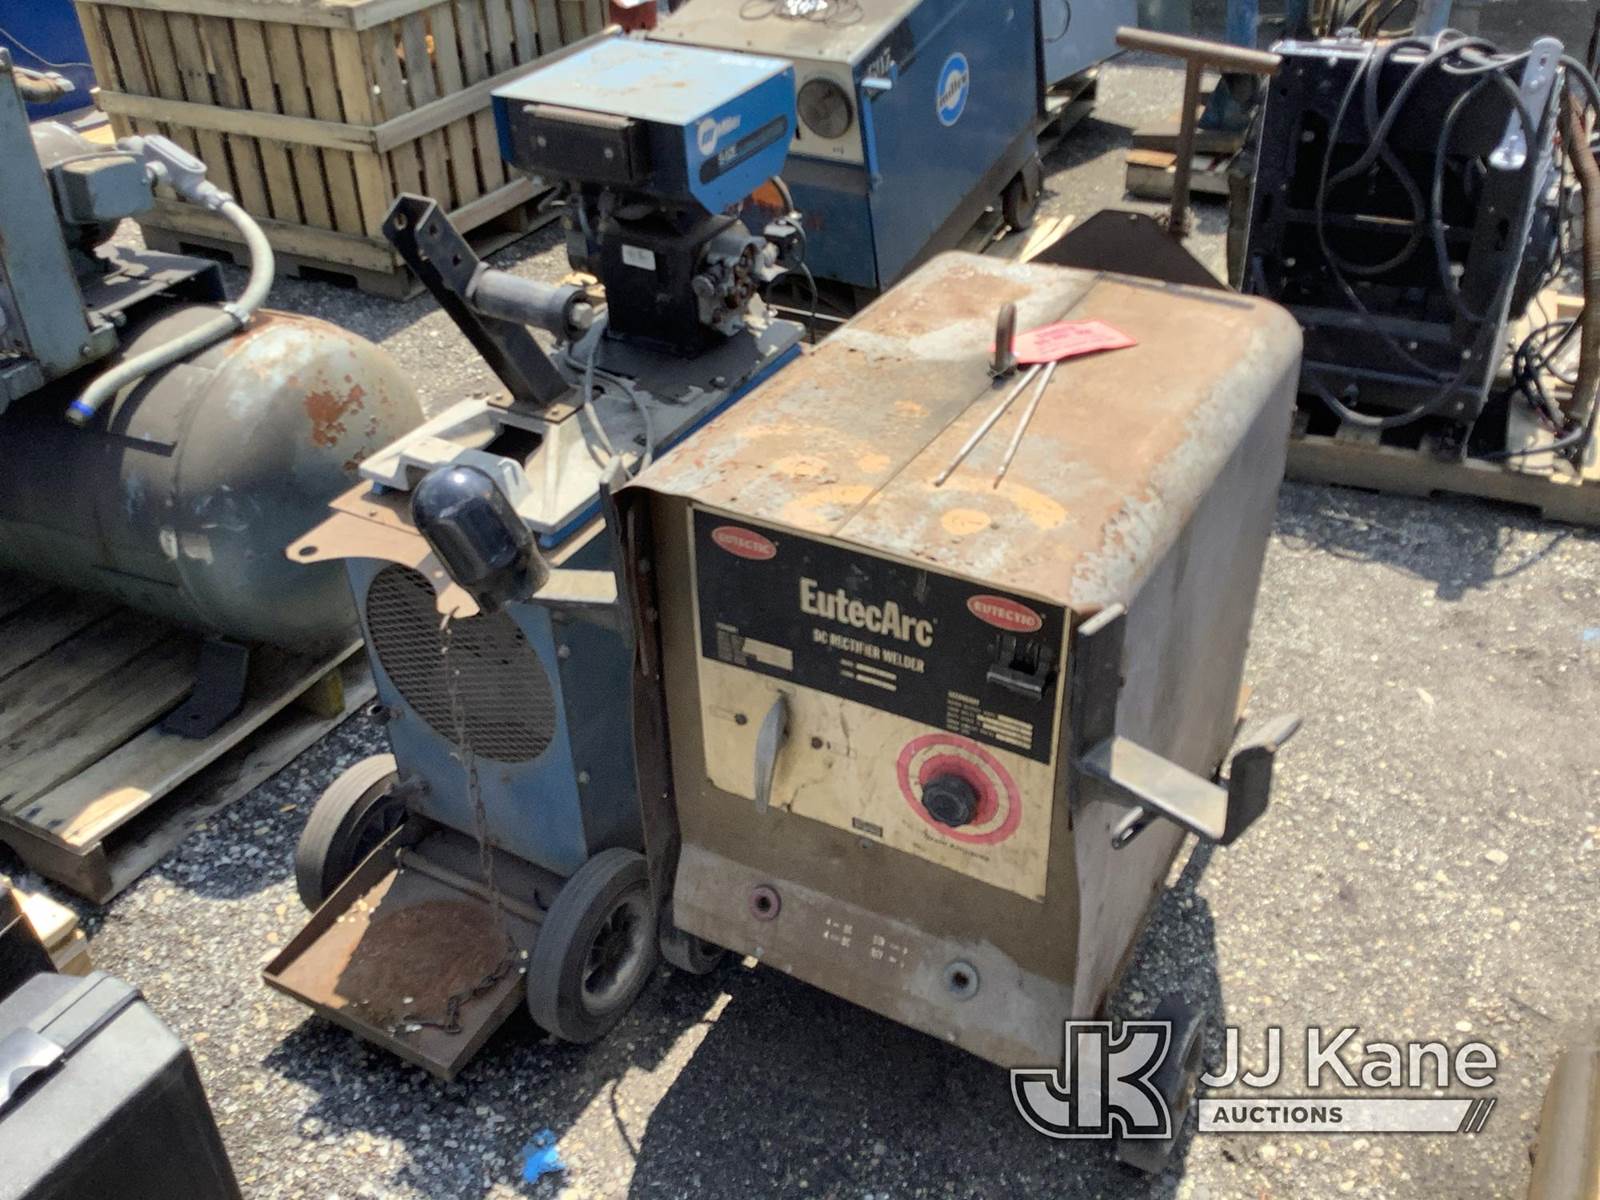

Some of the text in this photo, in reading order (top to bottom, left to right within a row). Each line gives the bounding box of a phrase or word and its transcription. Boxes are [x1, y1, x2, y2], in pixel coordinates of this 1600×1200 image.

[800, 576, 934, 648] EutecArc
[813, 628, 926, 674] DC RECTIFIER WELDER
